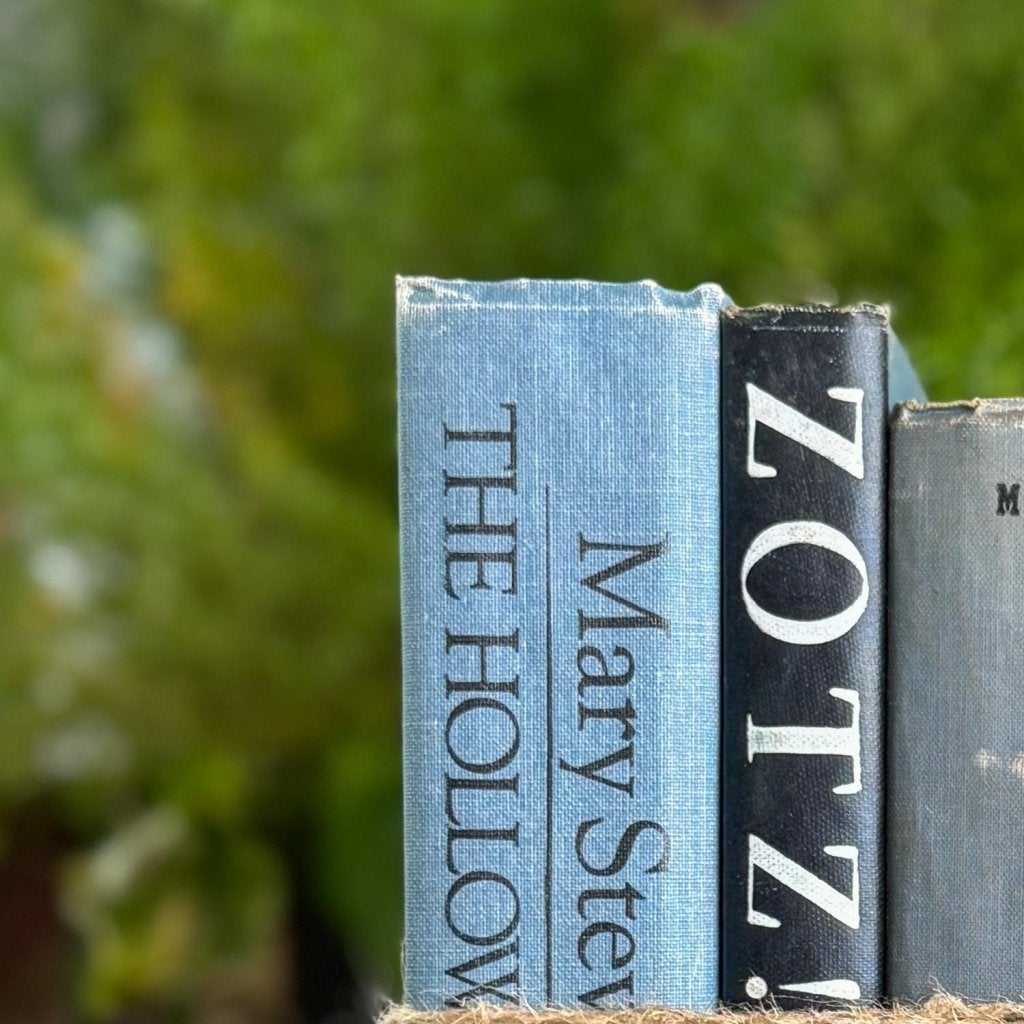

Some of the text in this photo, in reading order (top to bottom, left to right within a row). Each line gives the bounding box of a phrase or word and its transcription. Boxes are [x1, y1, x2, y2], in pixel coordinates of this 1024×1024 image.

[443, 401, 518, 600] THE
[445, 627, 521, 1007] HOLLOW
[558, 531, 671, 799] Mary
[741, 382, 869, 1001] ZOTZ!
